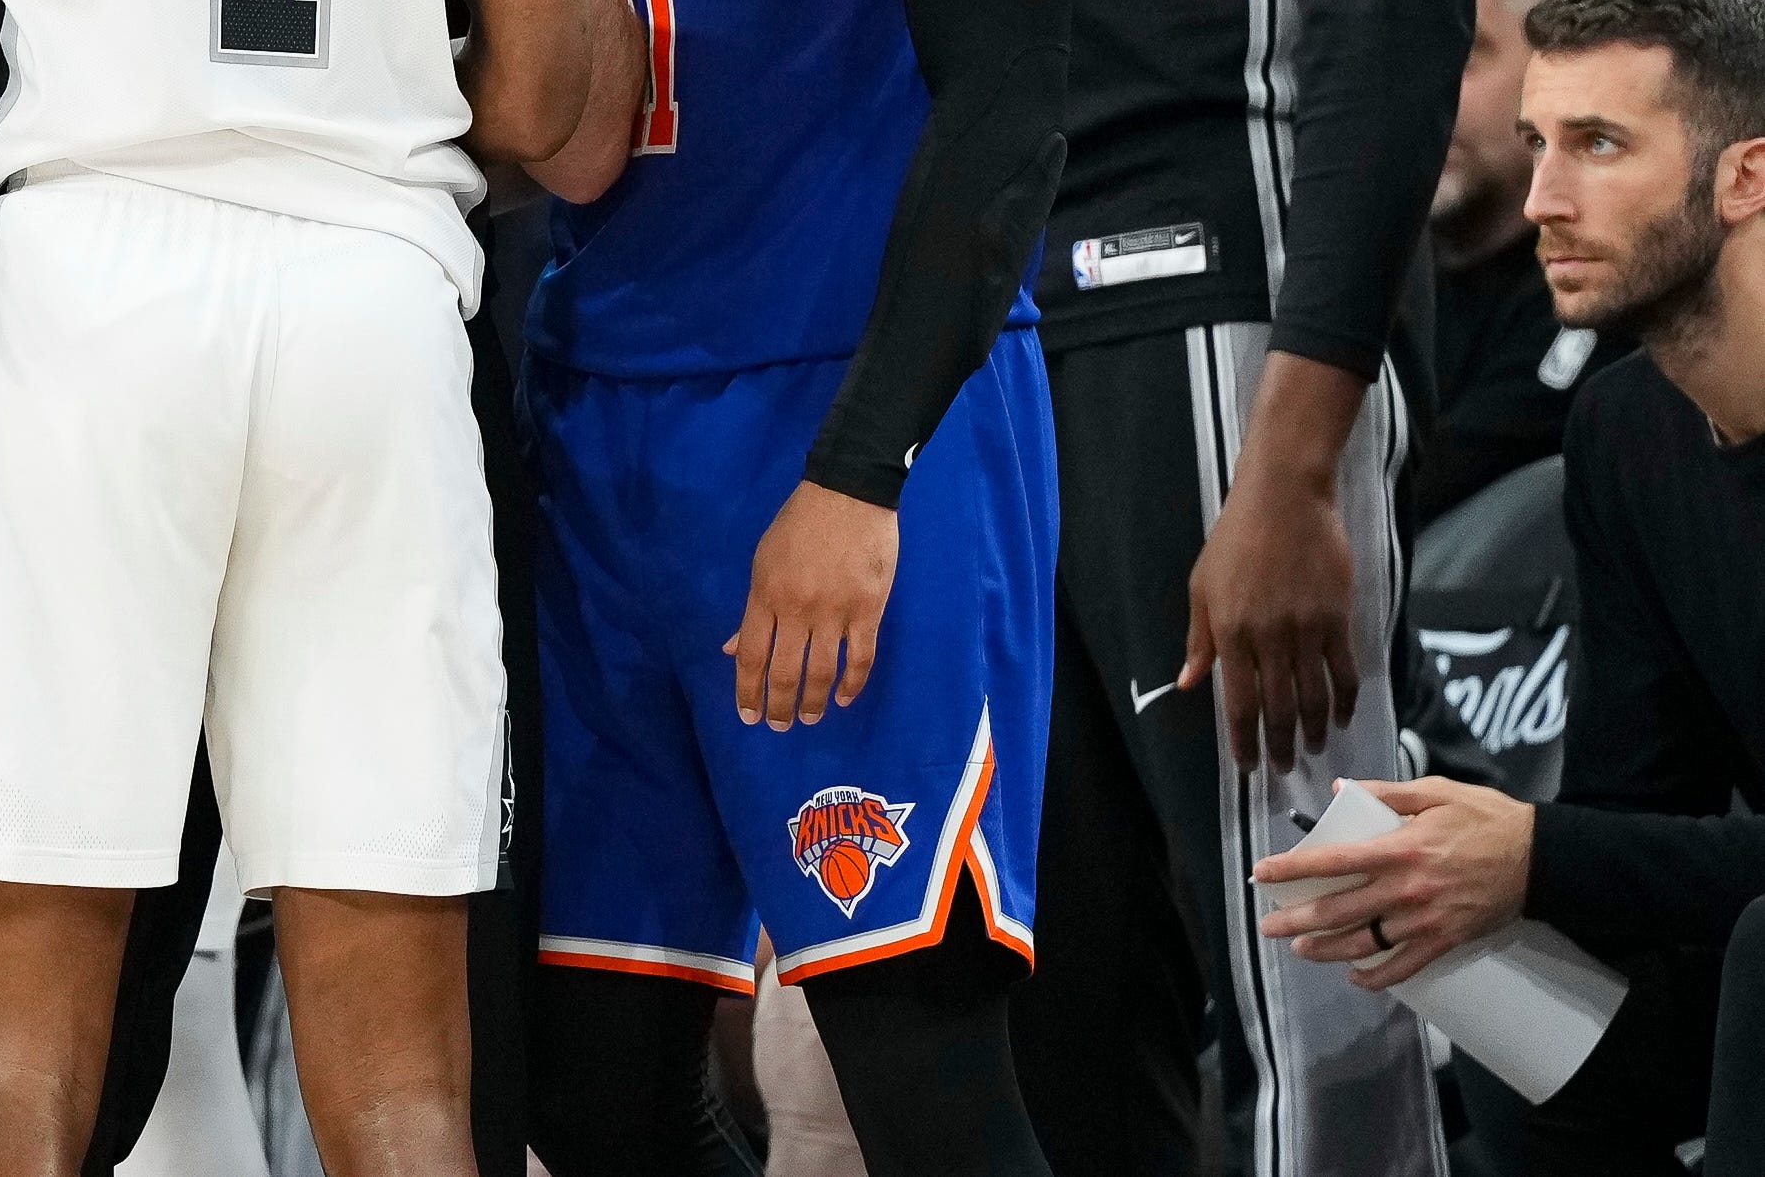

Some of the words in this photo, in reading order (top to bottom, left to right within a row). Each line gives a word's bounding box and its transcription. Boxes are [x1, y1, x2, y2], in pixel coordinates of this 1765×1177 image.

[814, 792, 833, 808] NEW
[834, 790, 861, 804] YORK
[795, 798, 904, 860] KNICKS
